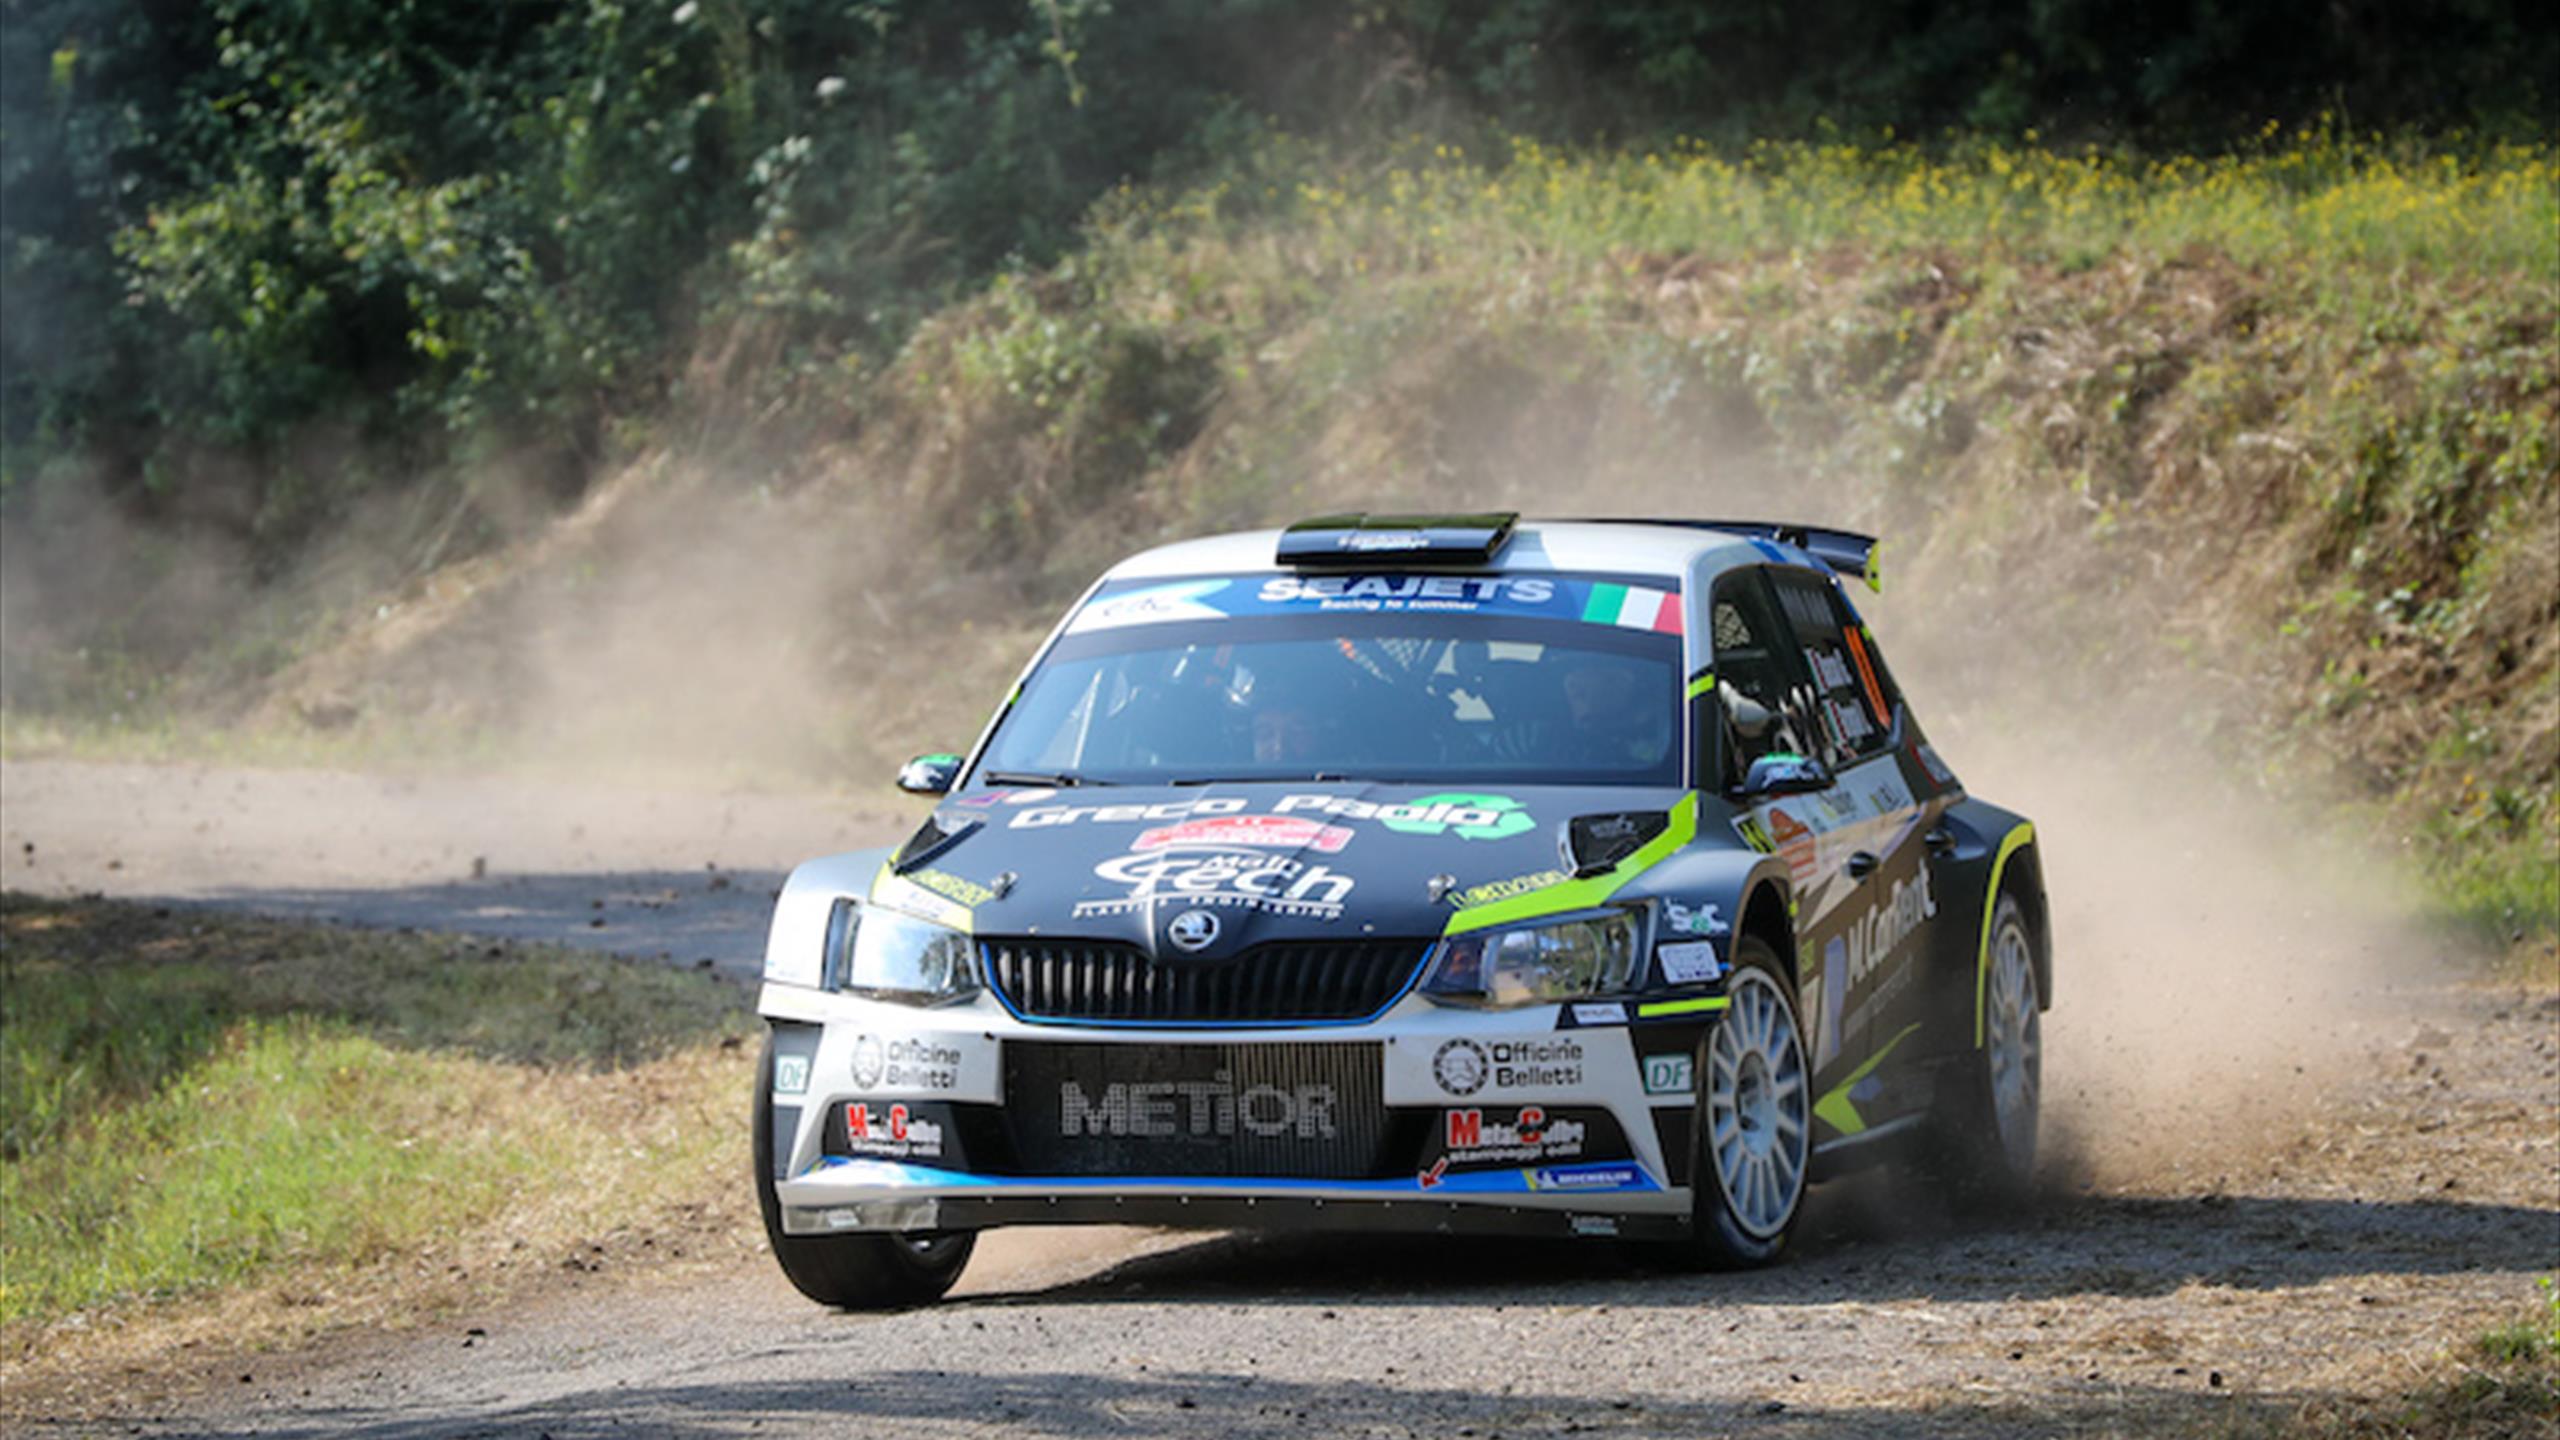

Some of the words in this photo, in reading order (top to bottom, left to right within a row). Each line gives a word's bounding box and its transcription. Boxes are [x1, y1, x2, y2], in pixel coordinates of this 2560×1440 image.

[1258, 576, 1553, 602] SEAJETS
[1008, 798, 1248, 828] Greco
[1272, 795, 1501, 826] Paolo
[887, 1041, 961, 1065] Officine
[1493, 1041, 1582, 1063] Officine
[886, 1064, 957, 1088] Belletti
[1496, 1064, 1583, 1087] Belletti
[1651, 1061, 1691, 1088] DF
[1557, 1171, 1633, 1184] MICHELIN
